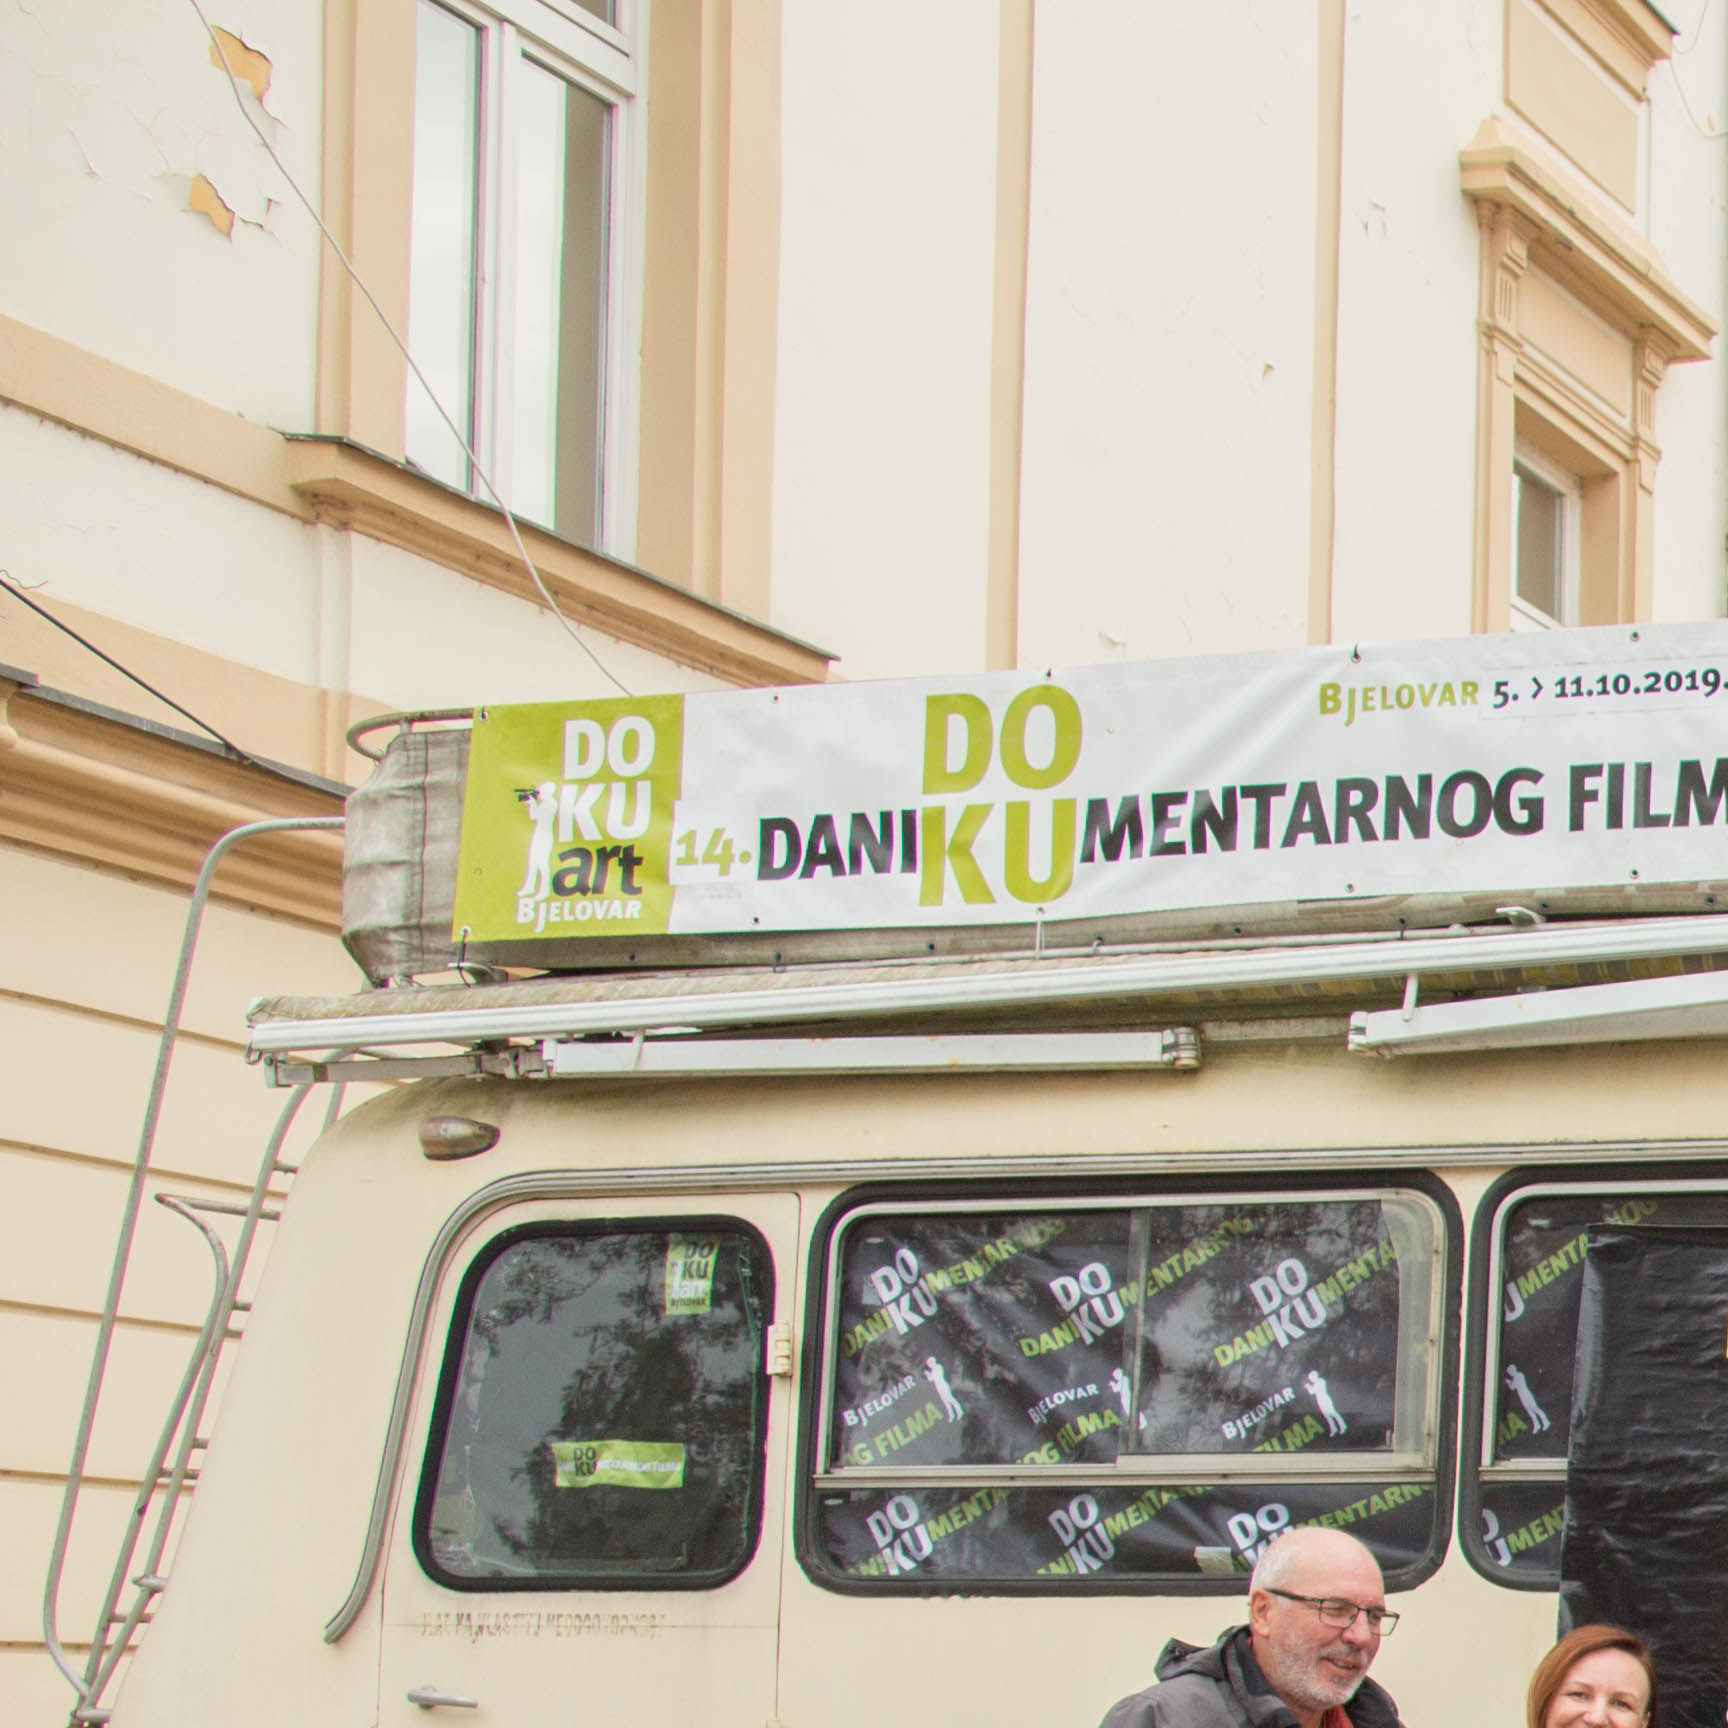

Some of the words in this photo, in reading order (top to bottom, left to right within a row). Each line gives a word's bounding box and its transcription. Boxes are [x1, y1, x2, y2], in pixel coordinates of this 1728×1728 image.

[1319, 679, 1478, 725] BJELOVAR
[1493, 681, 1519, 709] 5.
[562, 716, 656, 778] DO
[922, 684, 1082, 795] DO
[558, 781, 652, 842] KU
[676, 829, 753, 875] 14.
[757, 810, 917, 880] DANI
[919, 798, 1075, 907] KU
[1079, 767, 1544, 864] MENTARNOG
[551, 840, 644, 899] art
[516, 897, 642, 932] BJELOVAR
[870, 1248, 918, 1304] DO
[1050, 1263, 1111, 1312] DO
[1250, 1258, 1308, 1315] DO
[873, 1402, 945, 1457] FILMA
[866, 1495, 919, 1548] DO
[1048, 1494, 1098, 1546] DO
[1227, 1503, 1289, 1550] DO
